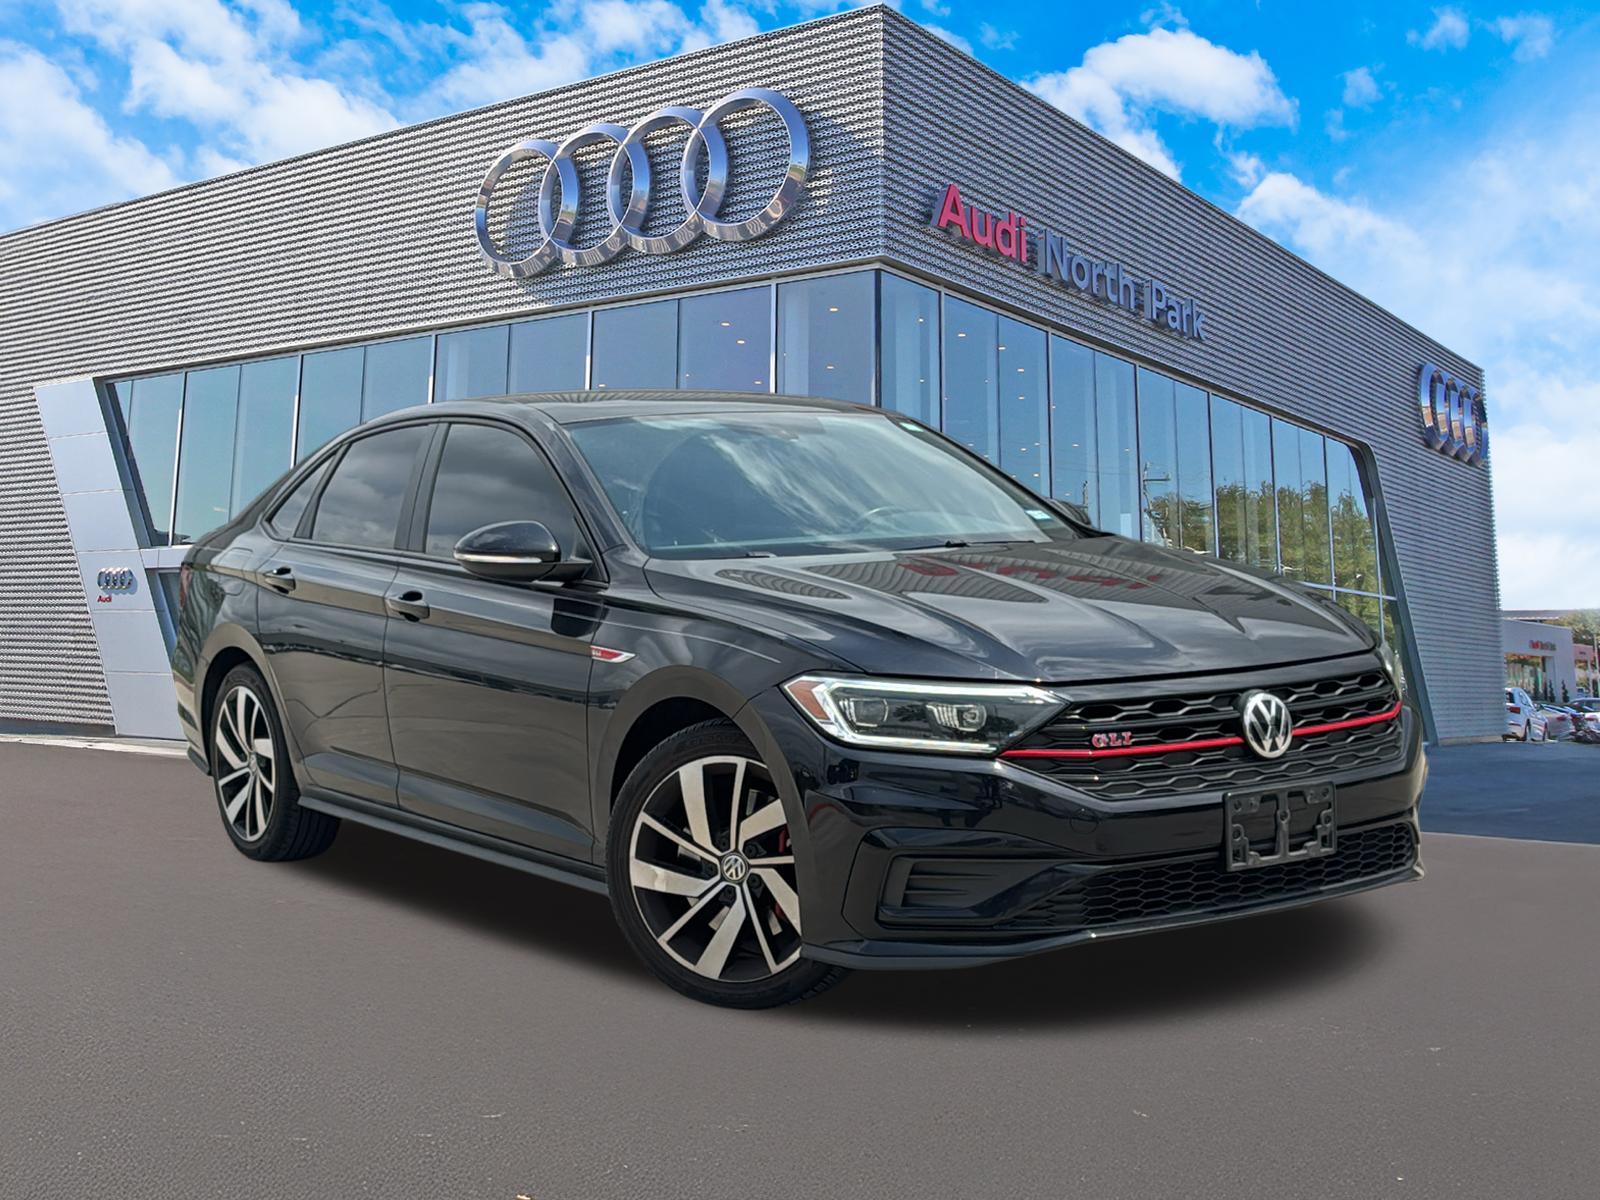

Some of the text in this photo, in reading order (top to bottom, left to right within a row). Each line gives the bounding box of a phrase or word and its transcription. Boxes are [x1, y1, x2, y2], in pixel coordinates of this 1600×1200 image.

[932, 183, 1206, 341] Audi North Park
[1091, 731, 1132, 748] GLI
[1243, 693, 1292, 758] VW
